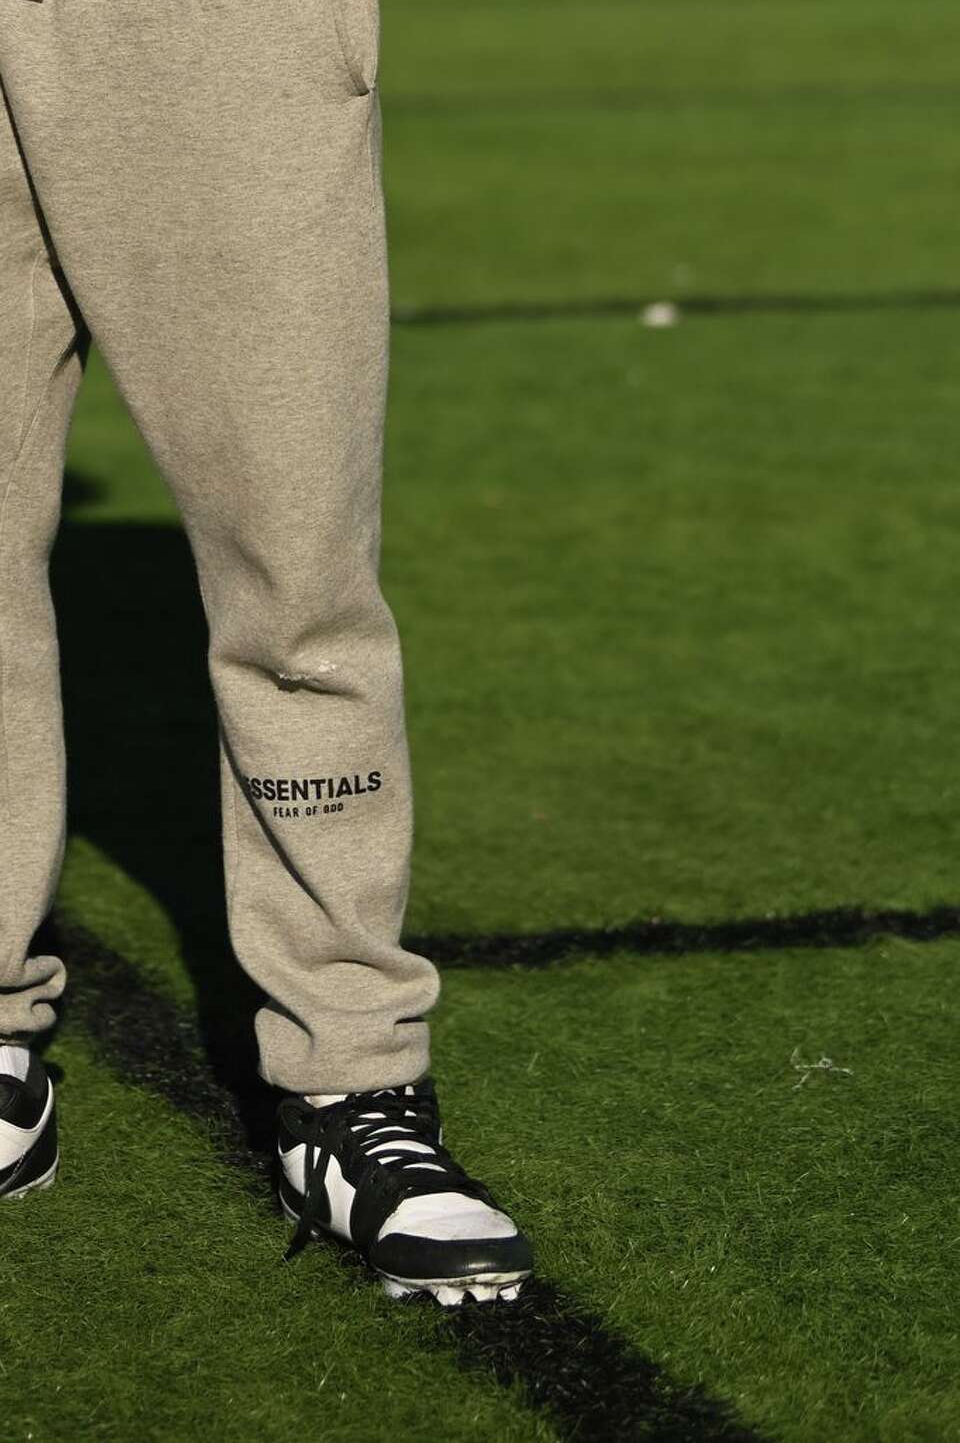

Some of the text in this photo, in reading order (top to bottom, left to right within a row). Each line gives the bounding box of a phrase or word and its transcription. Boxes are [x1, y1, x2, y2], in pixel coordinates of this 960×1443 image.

[243, 770, 382, 801] SSENTIALS
[273, 806, 299, 818] FEAR
[305, 805, 318, 816] OF
